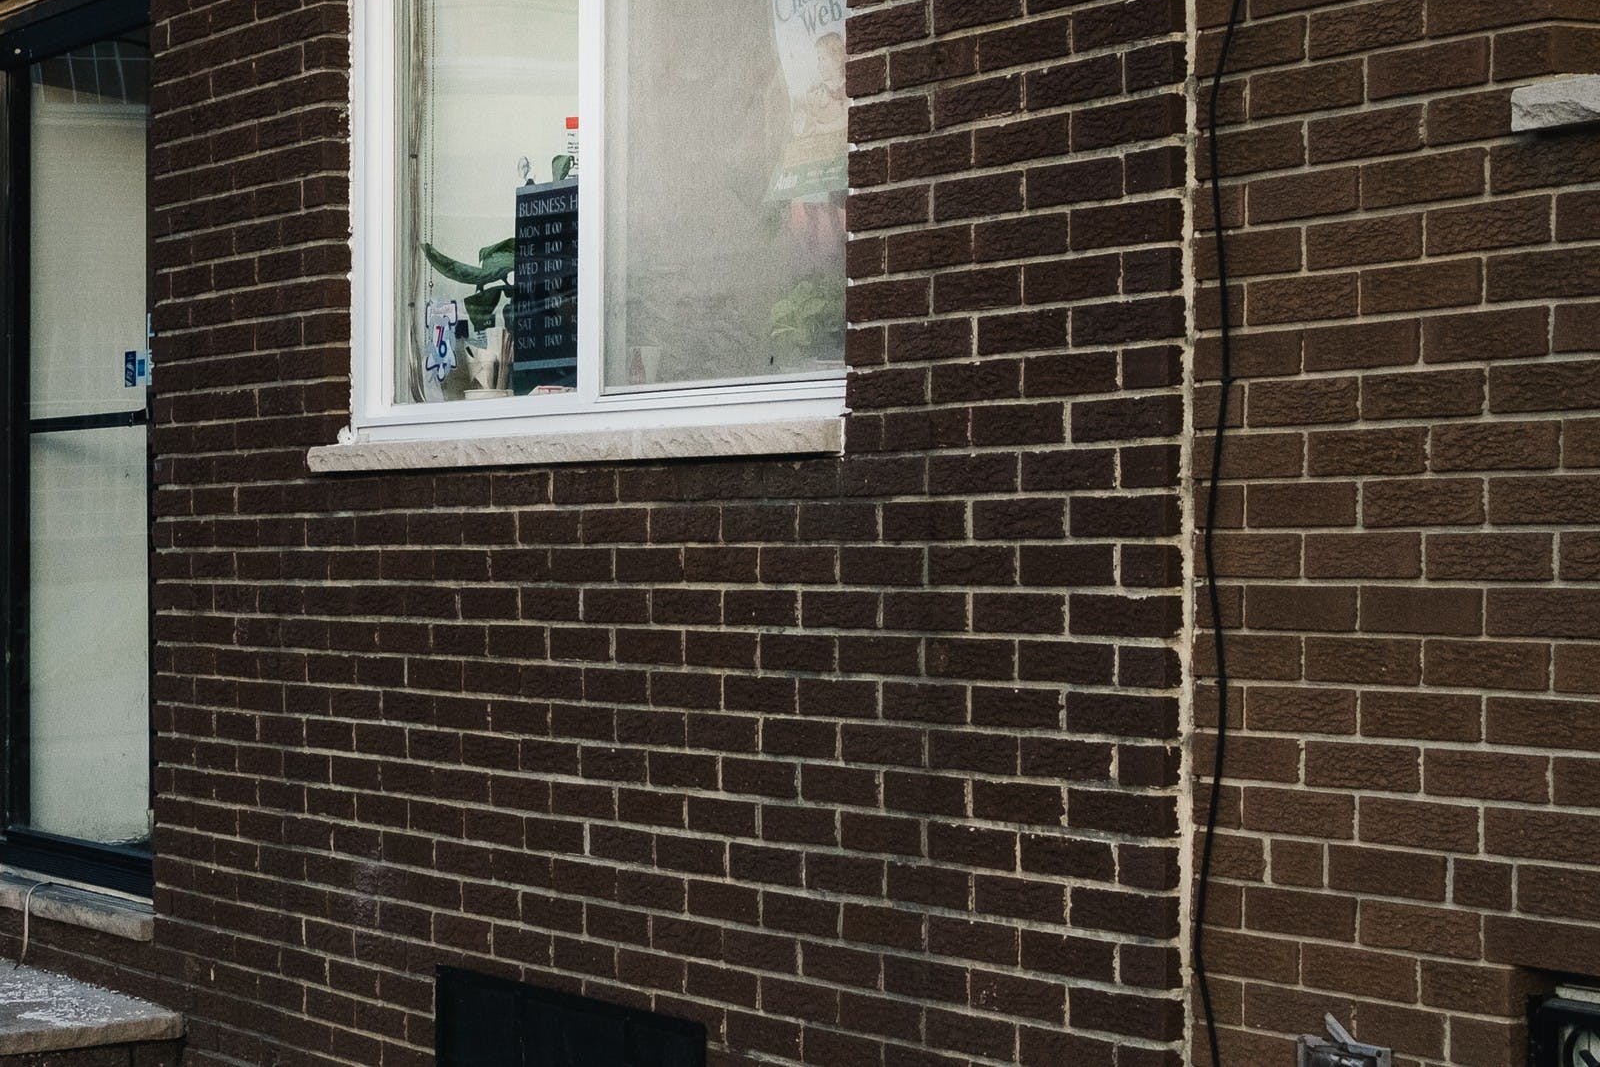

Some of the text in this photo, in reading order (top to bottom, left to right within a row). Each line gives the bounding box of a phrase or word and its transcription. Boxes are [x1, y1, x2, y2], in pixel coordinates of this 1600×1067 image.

[519, 195, 566, 218] BUSINESS
[519, 225, 540, 239] MON
[519, 243, 536, 258] TUE
[517, 261, 539, 276] WED
[517, 280, 537, 294] THU
[517, 317, 533, 331] SAT
[517, 335, 536, 350] SUN
